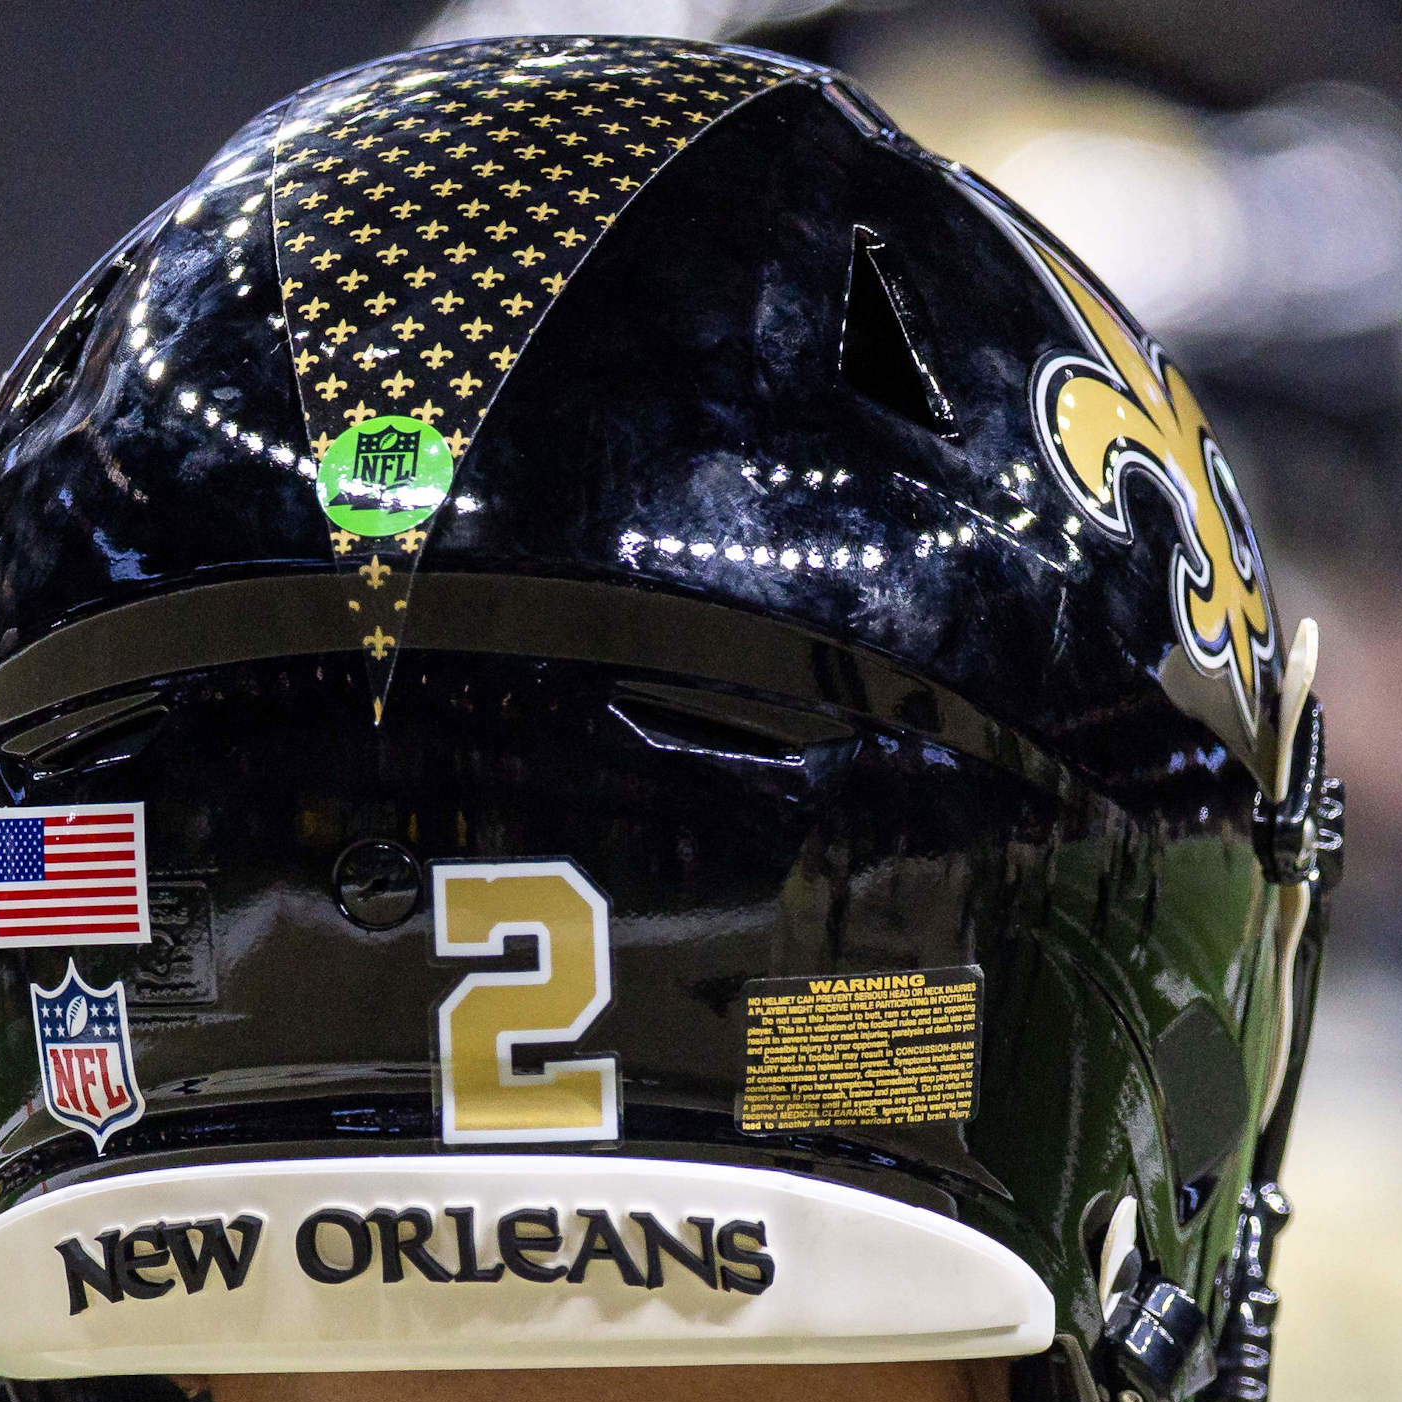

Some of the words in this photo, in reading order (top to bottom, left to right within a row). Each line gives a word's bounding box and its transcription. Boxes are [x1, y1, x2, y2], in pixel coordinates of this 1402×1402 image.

[361, 454, 410, 485] NFL
[809, 974, 925, 994] WARNING
[432, 862, 618, 1144] 2
[761, 996, 795, 1006] HELMET
[815, 993, 853, 1003] PREVENT
[854, 990, 888, 1001] SERIOUS
[889, 989, 910, 998] HEAD
[924, 986, 944, 995] NECK
[945, 984, 976, 994] INJURIES
[755, 1006, 787, 1015] PLAYER
[788, 1005, 814, 1014] MIGHT
[815, 1003, 849, 1012] RECEIVE
[850, 1001, 874, 1011] WHILE
[875, 997, 929, 1009] PARTICIPATING
[895, 1041, 975, 1055] CONCUSSION-BRAIN
[746, 1065, 779, 1074] INJURY
[50, 1048, 129, 1118] NFL
[780, 1109, 820, 1119] MEDICAL
[54, 1214, 263, 1316] NEW
[296, 1206, 776, 1295] ORLEANS
